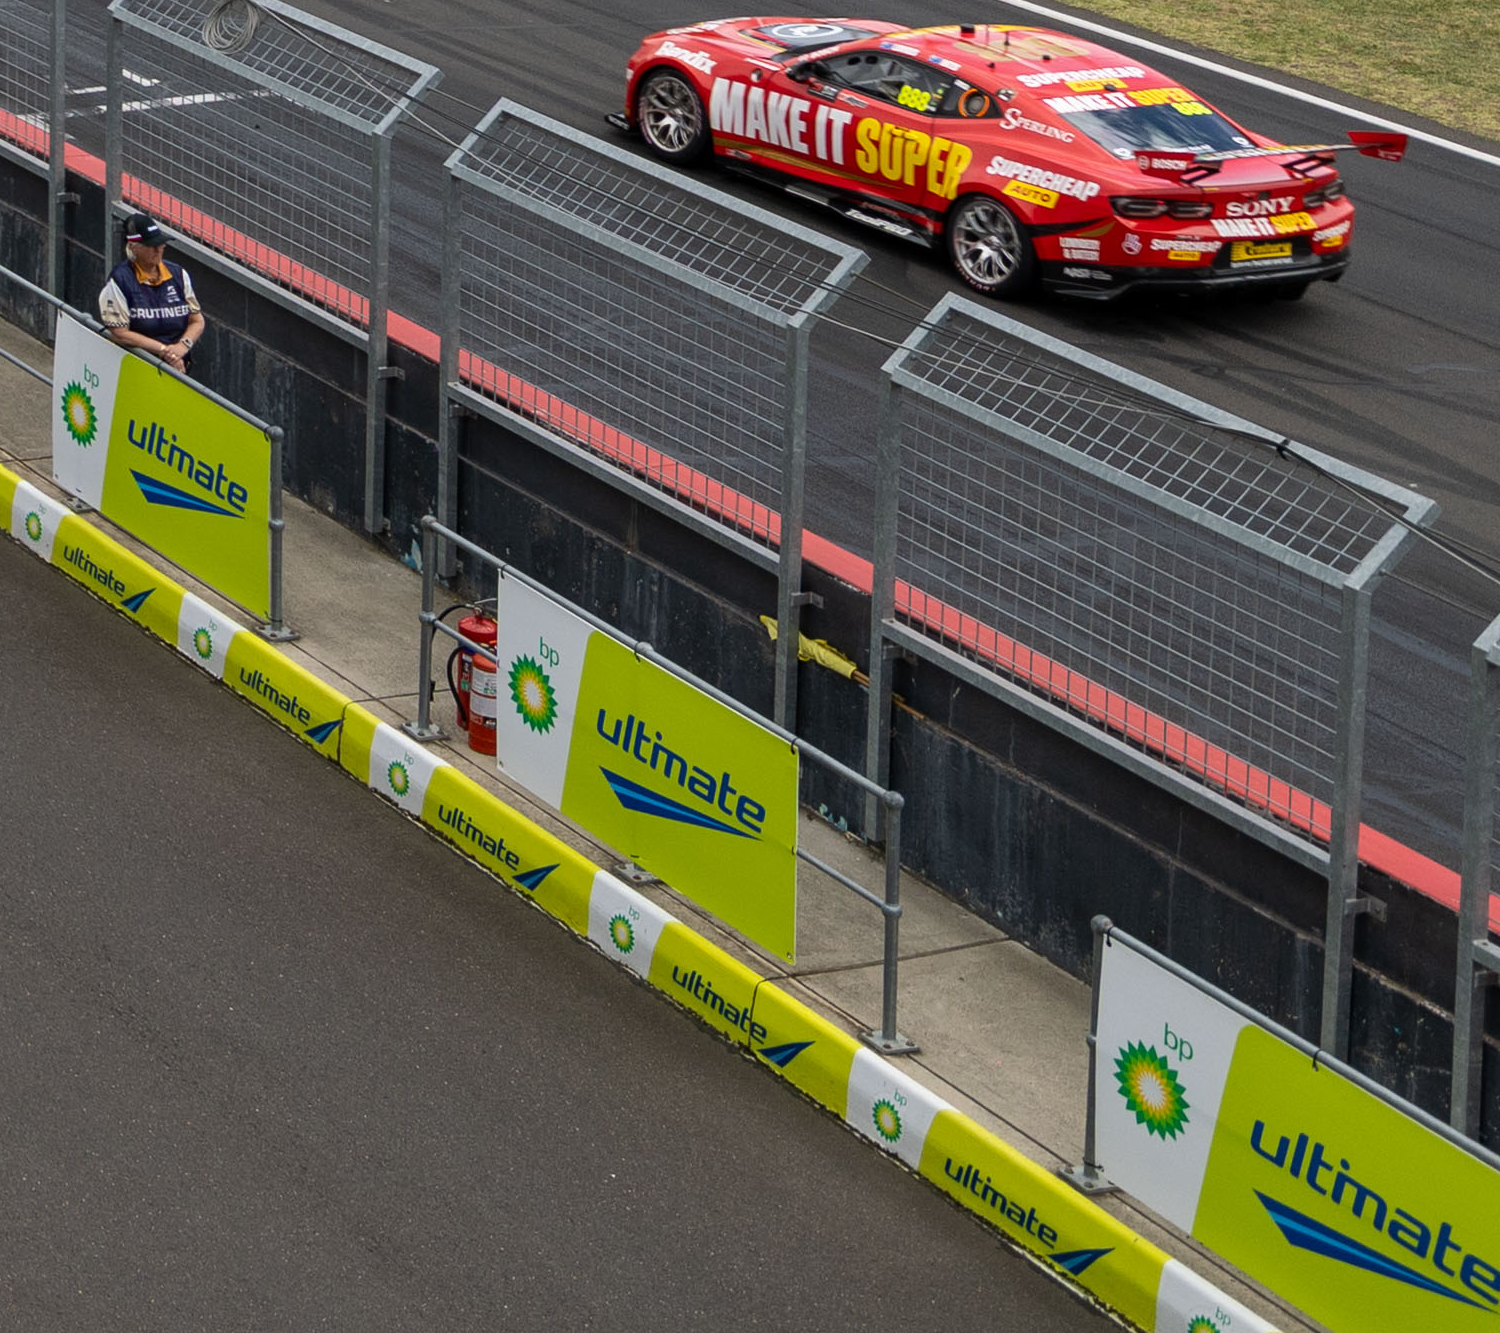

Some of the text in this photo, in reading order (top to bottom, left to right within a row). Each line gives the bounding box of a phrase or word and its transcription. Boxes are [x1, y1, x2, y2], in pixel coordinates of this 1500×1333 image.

[654, 41, 717, 76] Bendix
[1016, 65, 1146, 89] SUPERCHEAP
[897, 84, 932, 112] 888
[1042, 87, 1196, 114] MAKE IT SUPER
[708, 76, 973, 202] MAKE IT SUPER
[986, 156, 1100, 202] SUPERCHEAP
[1151, 157, 1188, 171] BOSCH
[1012, 184, 1051, 203] AUTO
[1225, 196, 1296, 217] SONY
[1211, 212, 1318, 238] MAKE IT SUPER
[1150, 237, 1223, 253] SUPERCHEAP
[83, 364, 100, 389] bp
[127, 418, 249, 513] ultimate
[63, 543, 126, 599] ultimate
[539, 636, 561, 669] bp
[239, 665, 311, 727] ultimate
[403, 750, 415, 767] bp
[595, 706, 768, 834] ultimate
[438, 802, 520, 872] ultimate
[627, 905, 640, 923] bp
[671, 962, 767, 1045] ultimate
[1163, 1022, 1194, 1062] bp
[895, 1087, 908, 1108] bp
[943, 1155, 1059, 1249] ultimate
[1250, 1119, 1500, 1306] ultimate
[1214, 1305, 1232, 1326] bp
